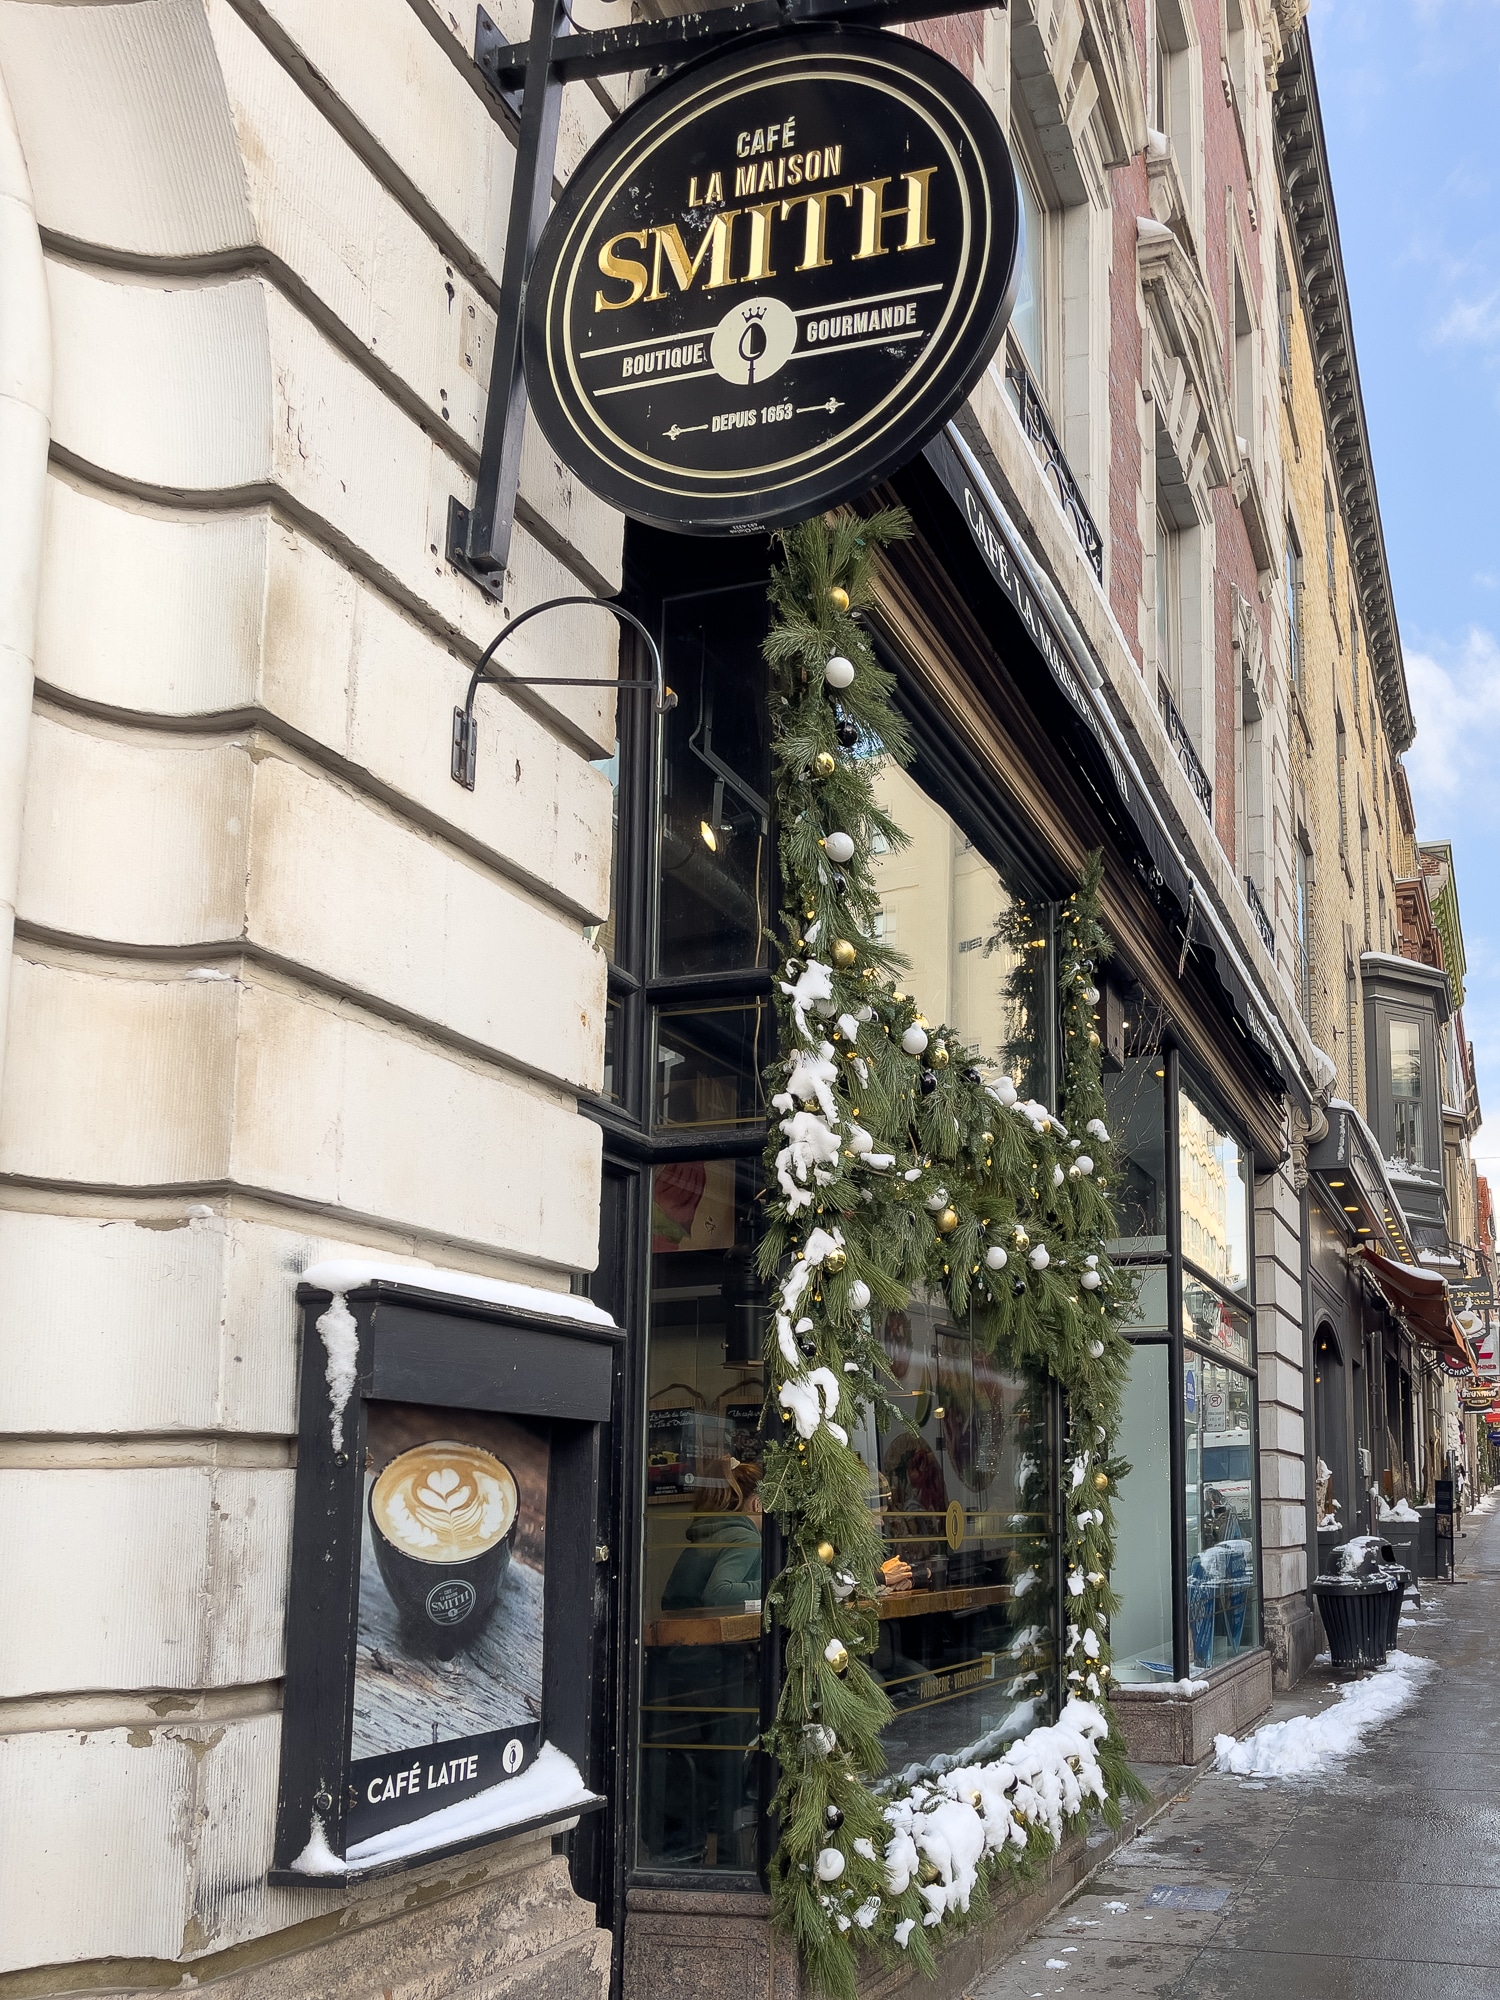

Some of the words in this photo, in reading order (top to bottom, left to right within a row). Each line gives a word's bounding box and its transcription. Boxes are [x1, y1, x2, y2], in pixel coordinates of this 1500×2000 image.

[736, 116, 796, 158] CAFÉ
[688, 172, 723, 207] LA
[735, 144, 842, 197] MAISON
[595, 166, 938, 313] SMITH
[622, 342, 704, 378] BOUTIQUE
[806, 303, 917, 343] GOURMANDE
[711, 409, 757, 433] DEPUIS
[760, 403, 793, 426] 1653
[964, 487, 1012, 591] CAFÉ
[1012, 572, 1038, 638] LA
[431, 1590, 470, 1612] SMITH
[367, 1762, 420, 1804] CAFÉ
[427, 1754, 478, 1790] LATTE
